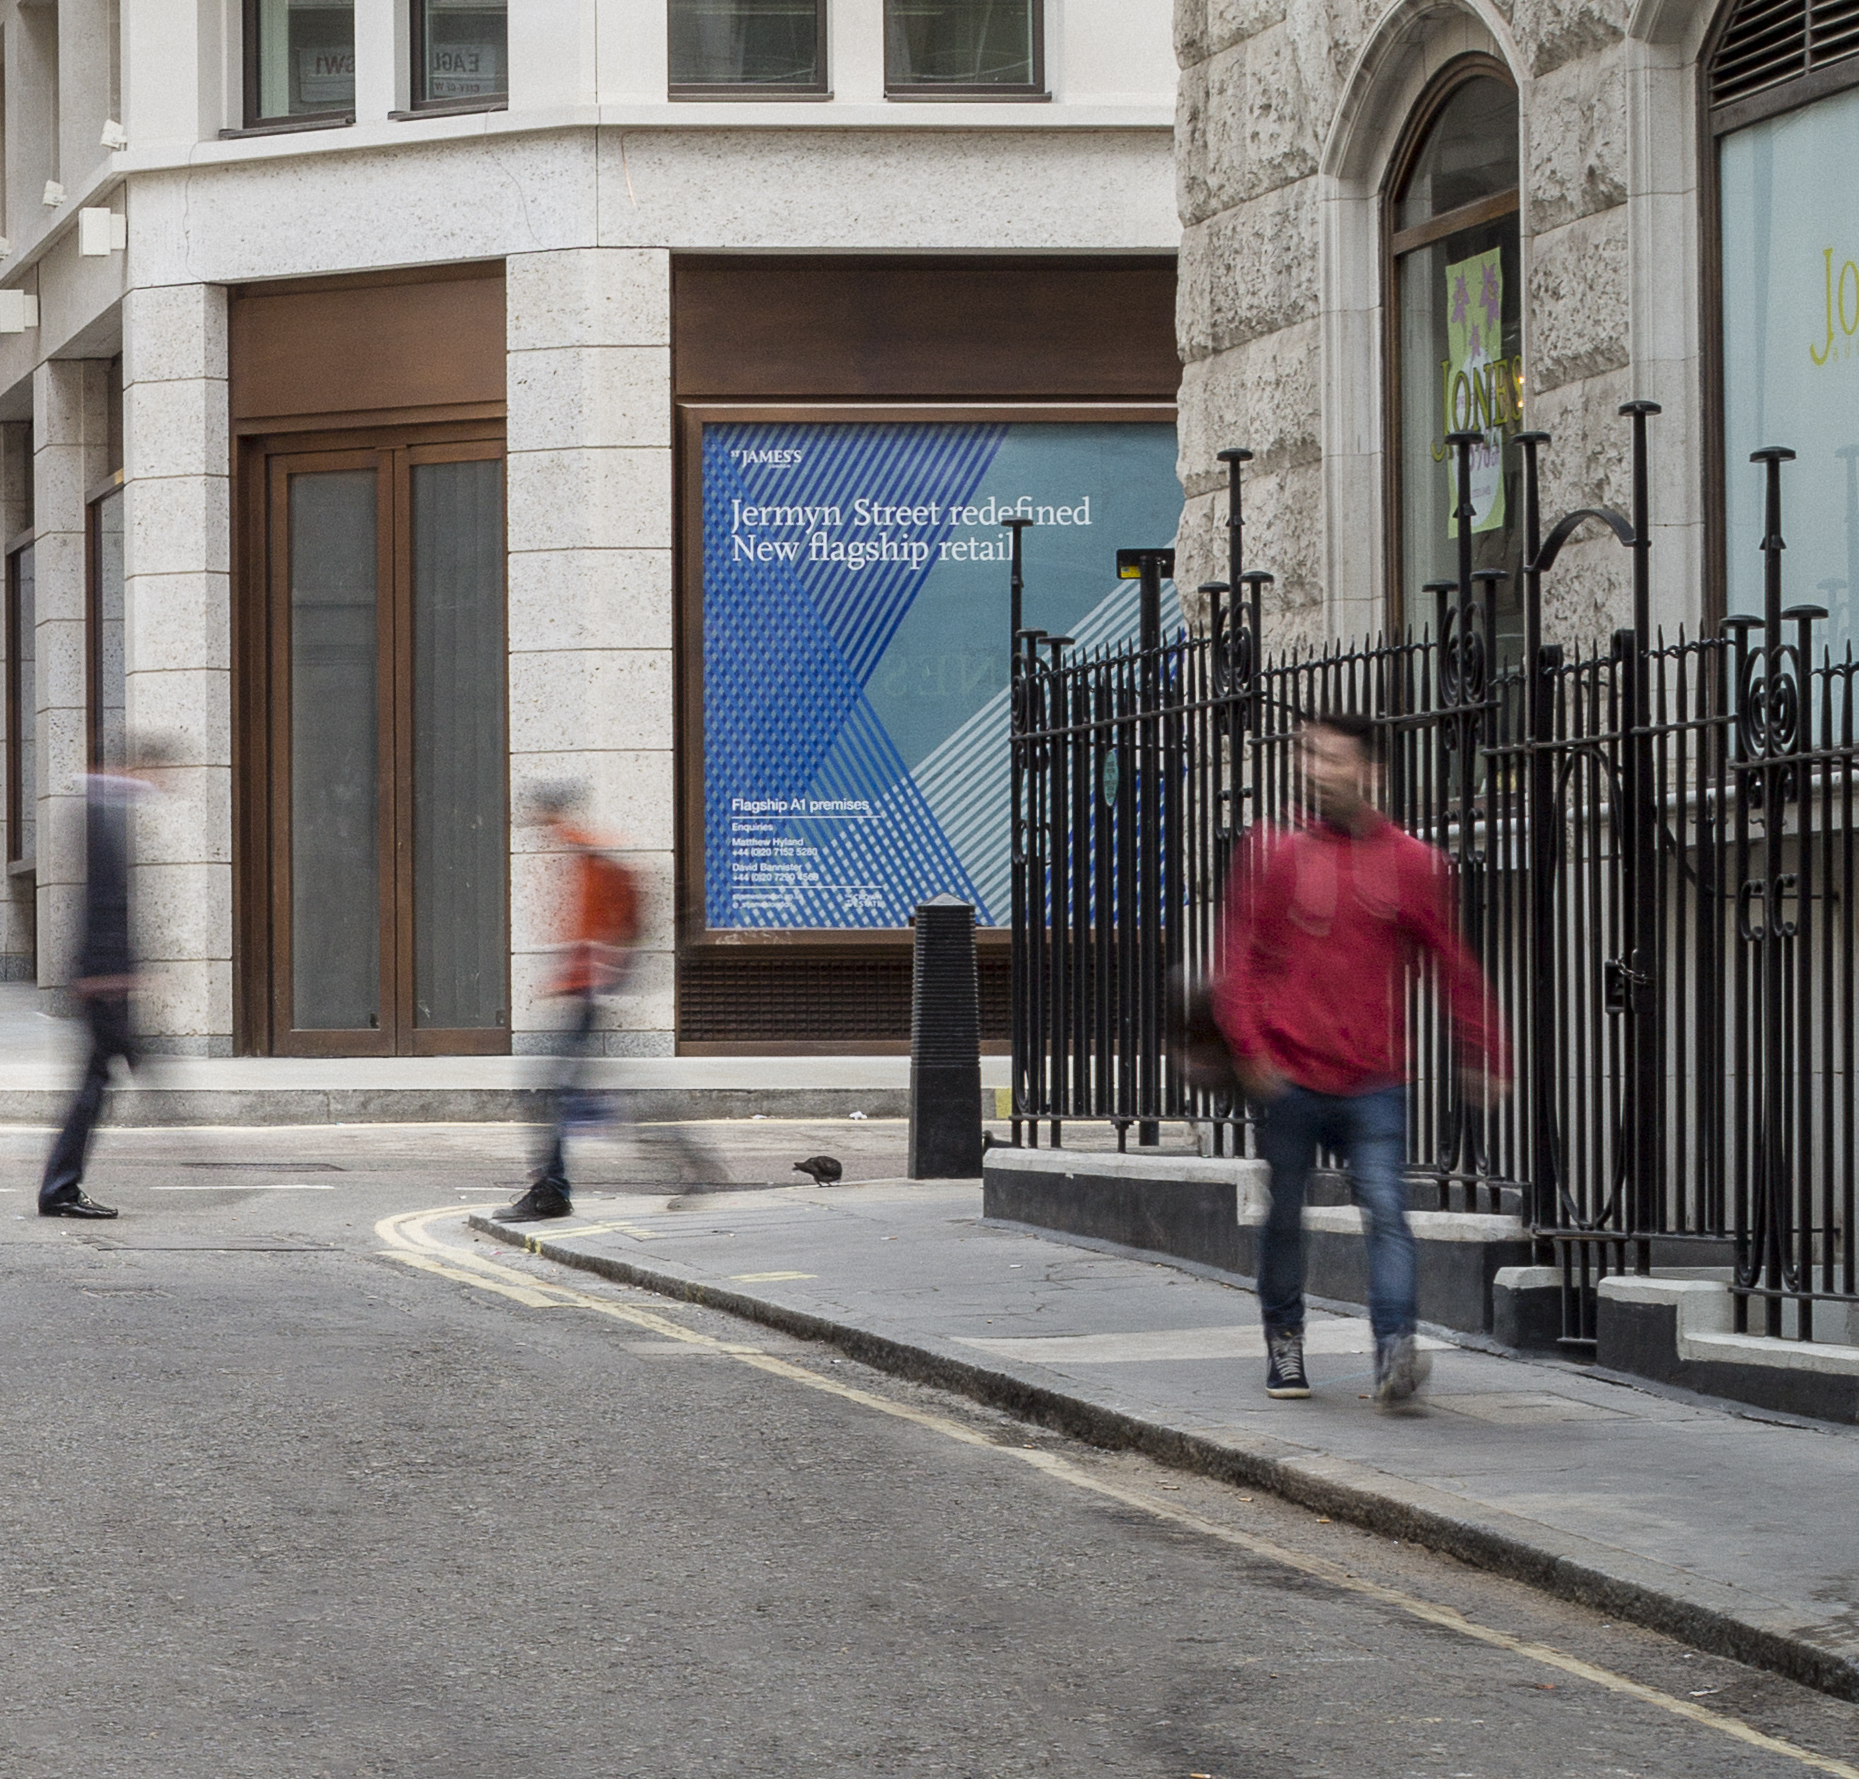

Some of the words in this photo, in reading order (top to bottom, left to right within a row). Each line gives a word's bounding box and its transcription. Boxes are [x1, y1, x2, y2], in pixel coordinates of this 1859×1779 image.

[730, 498, 841, 535] Jermyn
[853, 498, 940, 527] Street
[949, 496, 1093, 527] redefined
[731, 534, 800, 562] New
[808, 532, 929, 571] flagship
[938, 532, 1014, 562] retail
[731, 798, 788, 814] Flagship
[790, 799, 806, 811] A1
[809, 798, 870, 813] premises
[731, 822, 774, 833] Enquiries
[731, 837, 771, 847] Matthew
[772, 837, 804, 847] Hyland
[732, 847, 749, 856] +44
[732, 863, 758, 872] David
[760, 863, 802, 872] Bannister
[732, 873, 749, 882] +44
